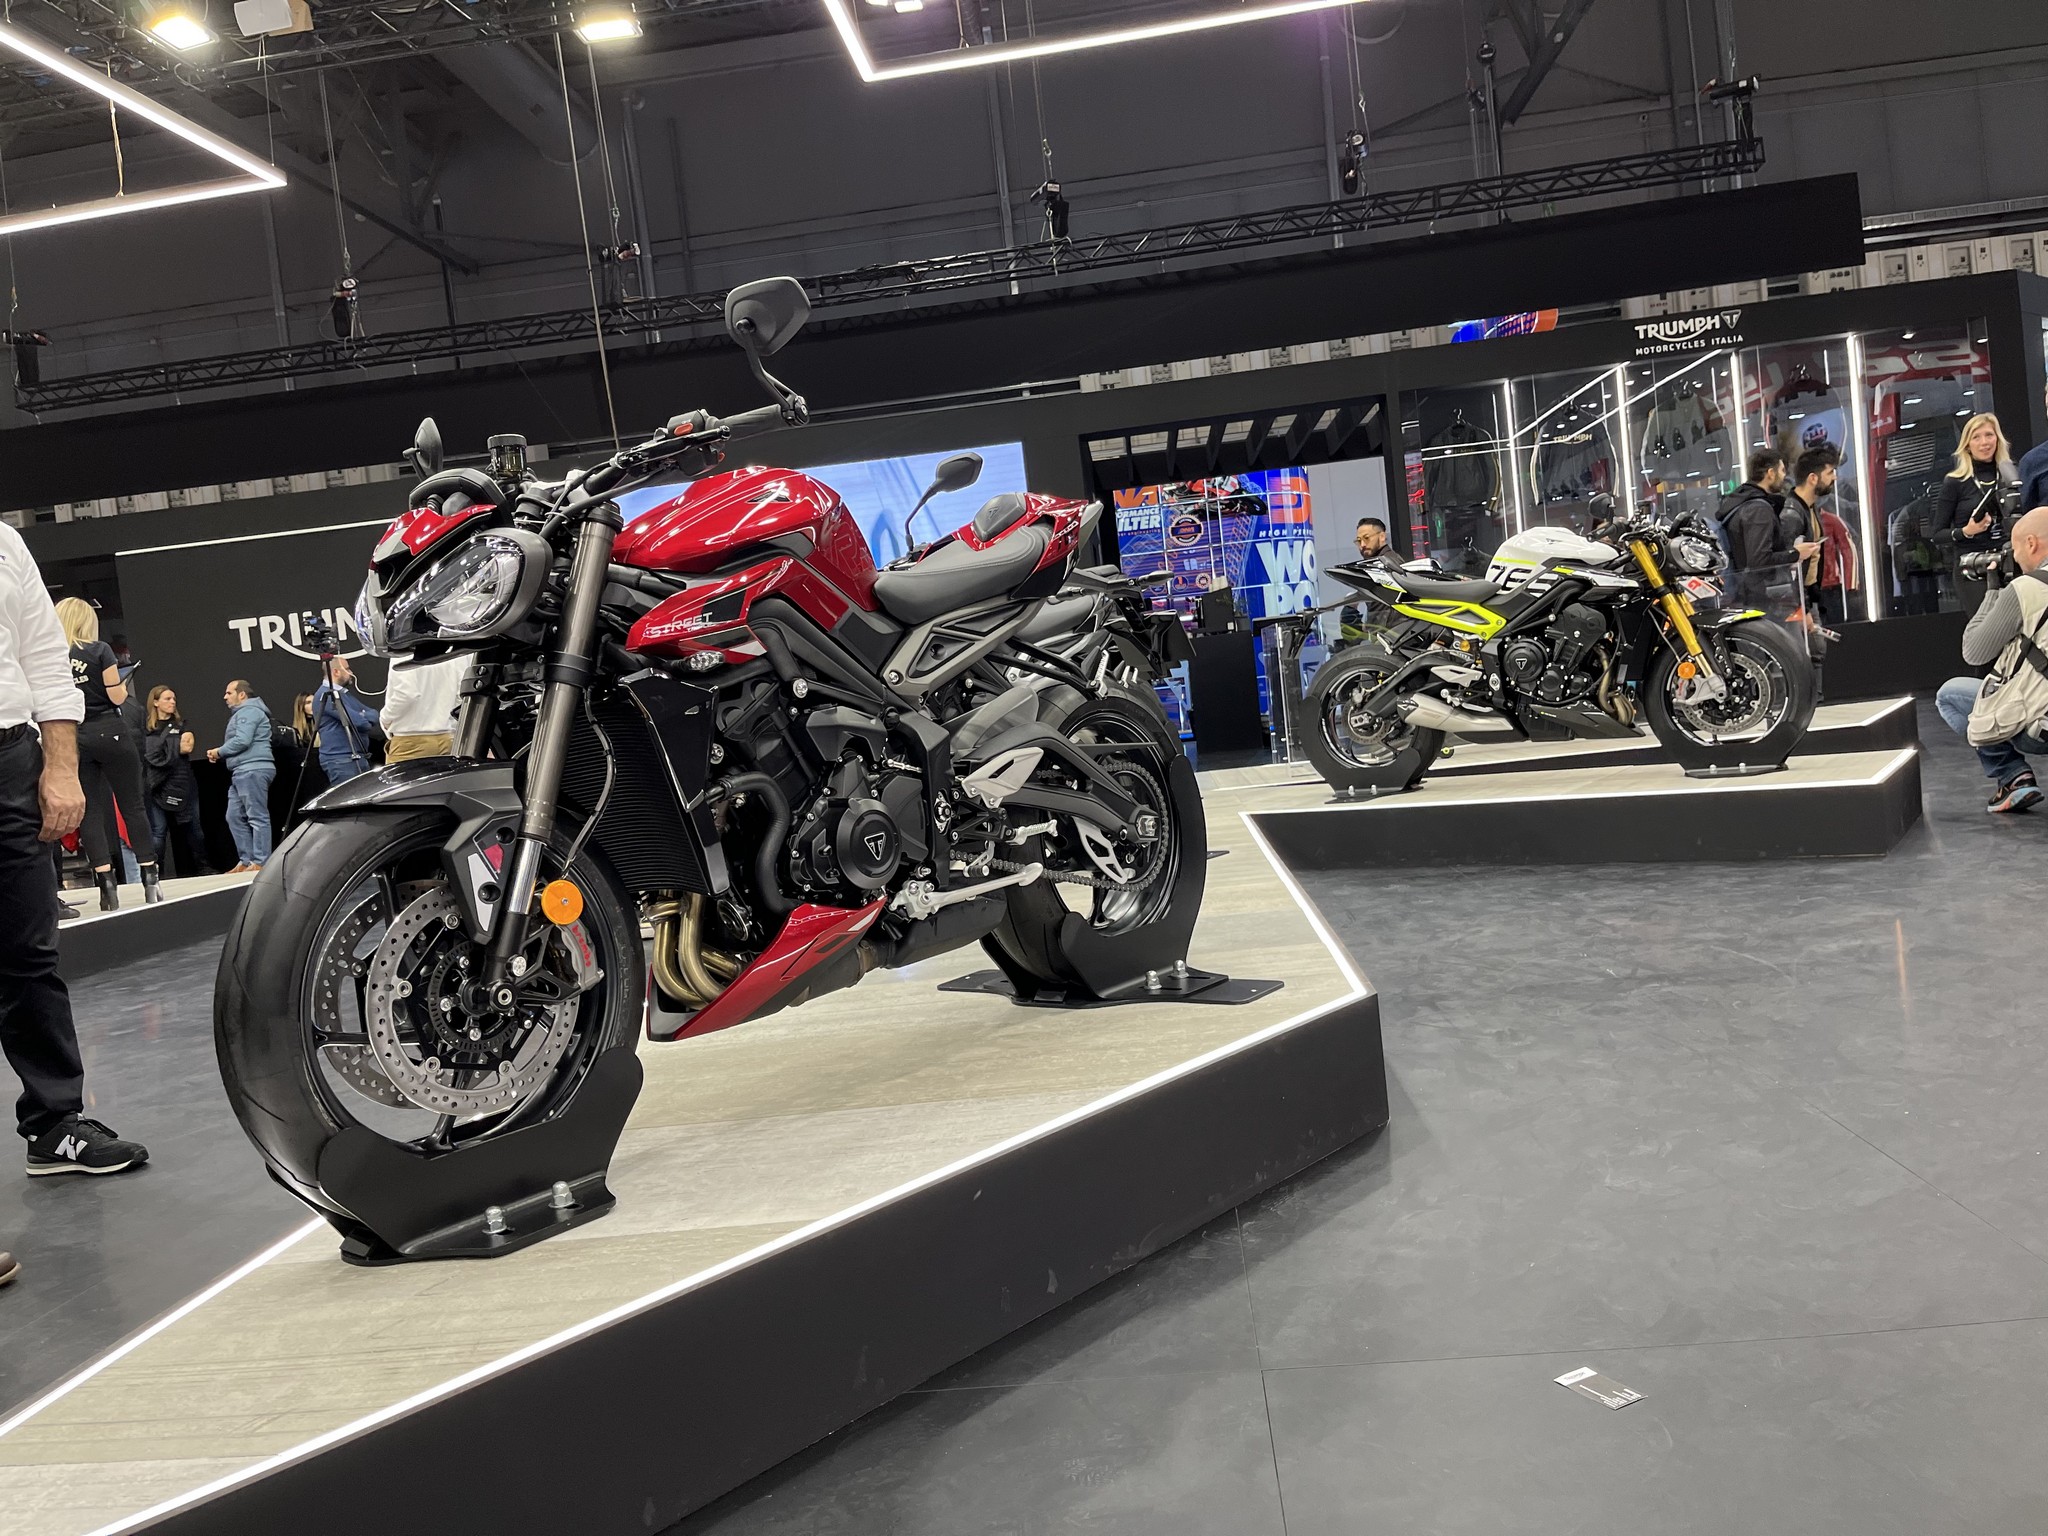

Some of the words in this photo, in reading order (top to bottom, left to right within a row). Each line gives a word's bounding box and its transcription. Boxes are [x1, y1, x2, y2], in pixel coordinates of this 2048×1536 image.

[1634, 314, 1721, 342] TRIUMPH
[1635, 339, 1706, 356] MOTORCYCLES
[1711, 334, 1744, 346] ITALIA
[1117, 515, 1161, 532] ILTER
[650, 611, 713, 637] STREET
[571, 924, 592, 968] brembo
